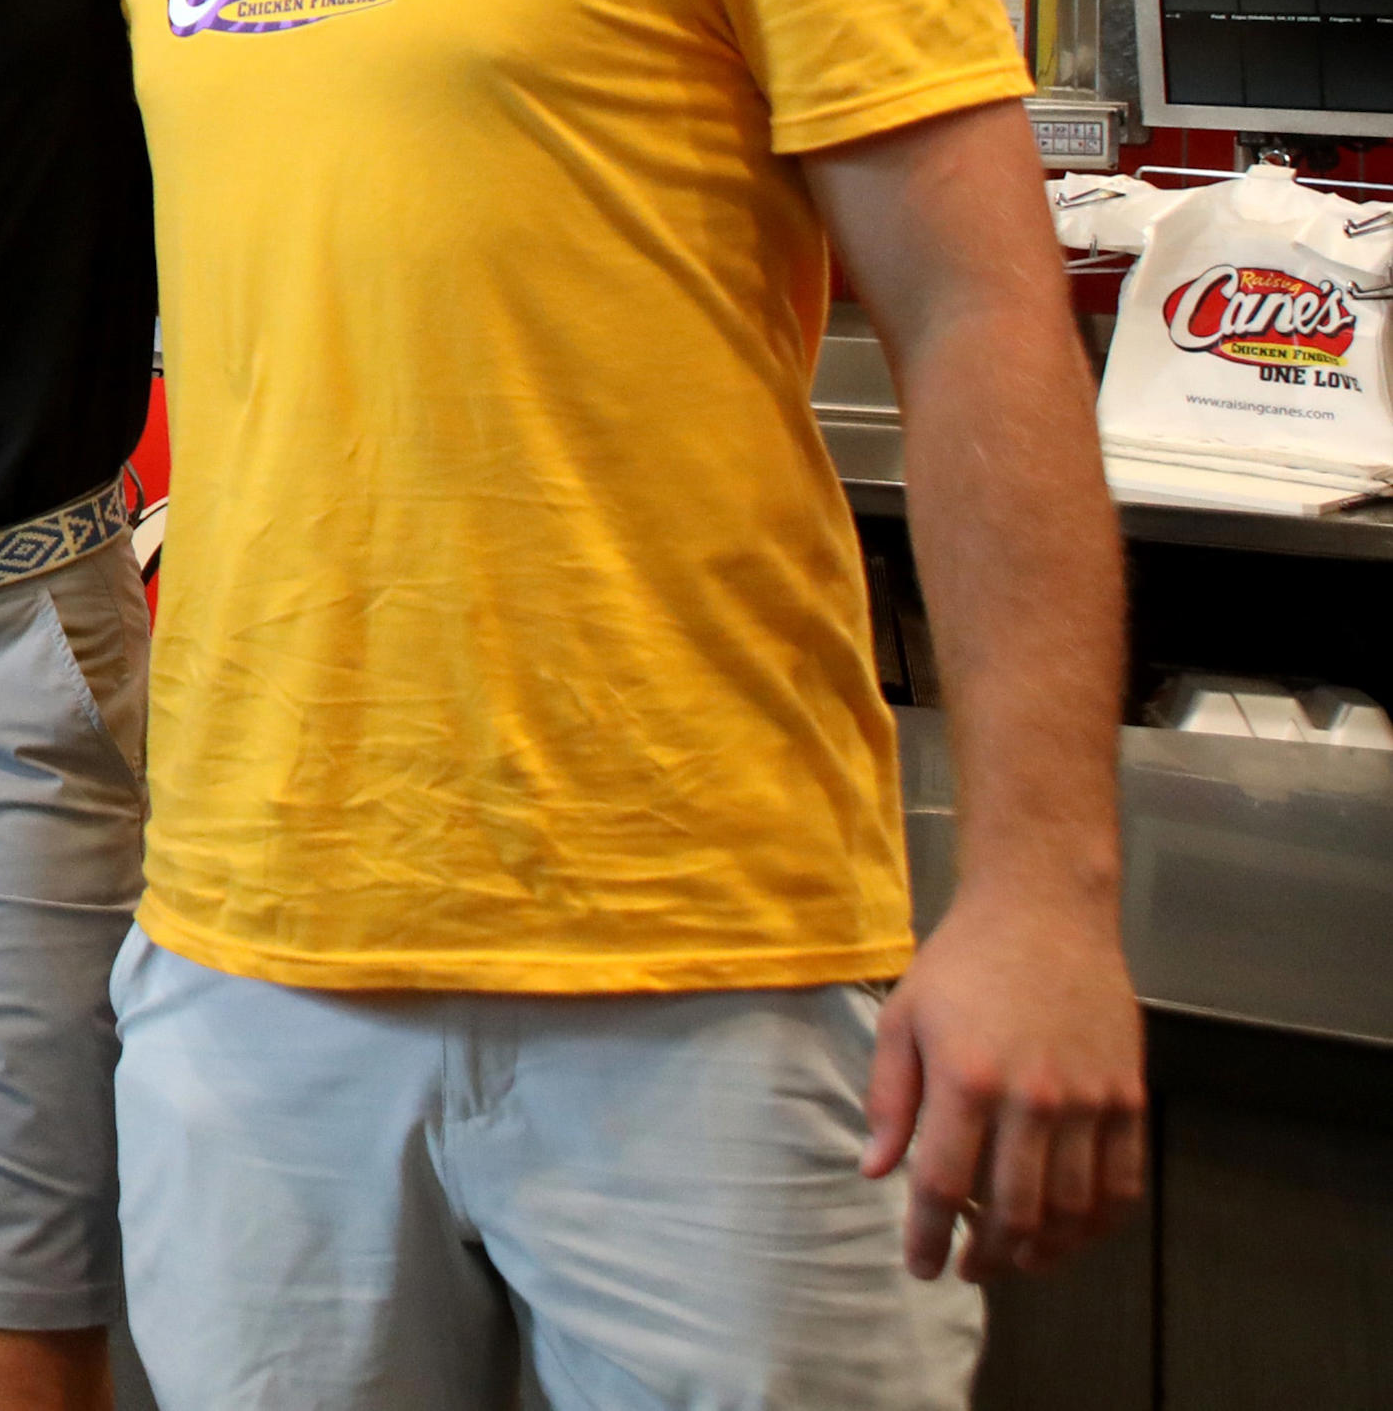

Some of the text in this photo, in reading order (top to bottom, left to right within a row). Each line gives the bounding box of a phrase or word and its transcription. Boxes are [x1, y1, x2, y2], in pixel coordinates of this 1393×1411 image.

[1169, 265, 1356, 350] Cane's
[1231, 343, 1288, 359] CHICKEN
[1260, 366, 1307, 386] ONE
[1186, 394, 1335, 421] www.raisingcanes.com
